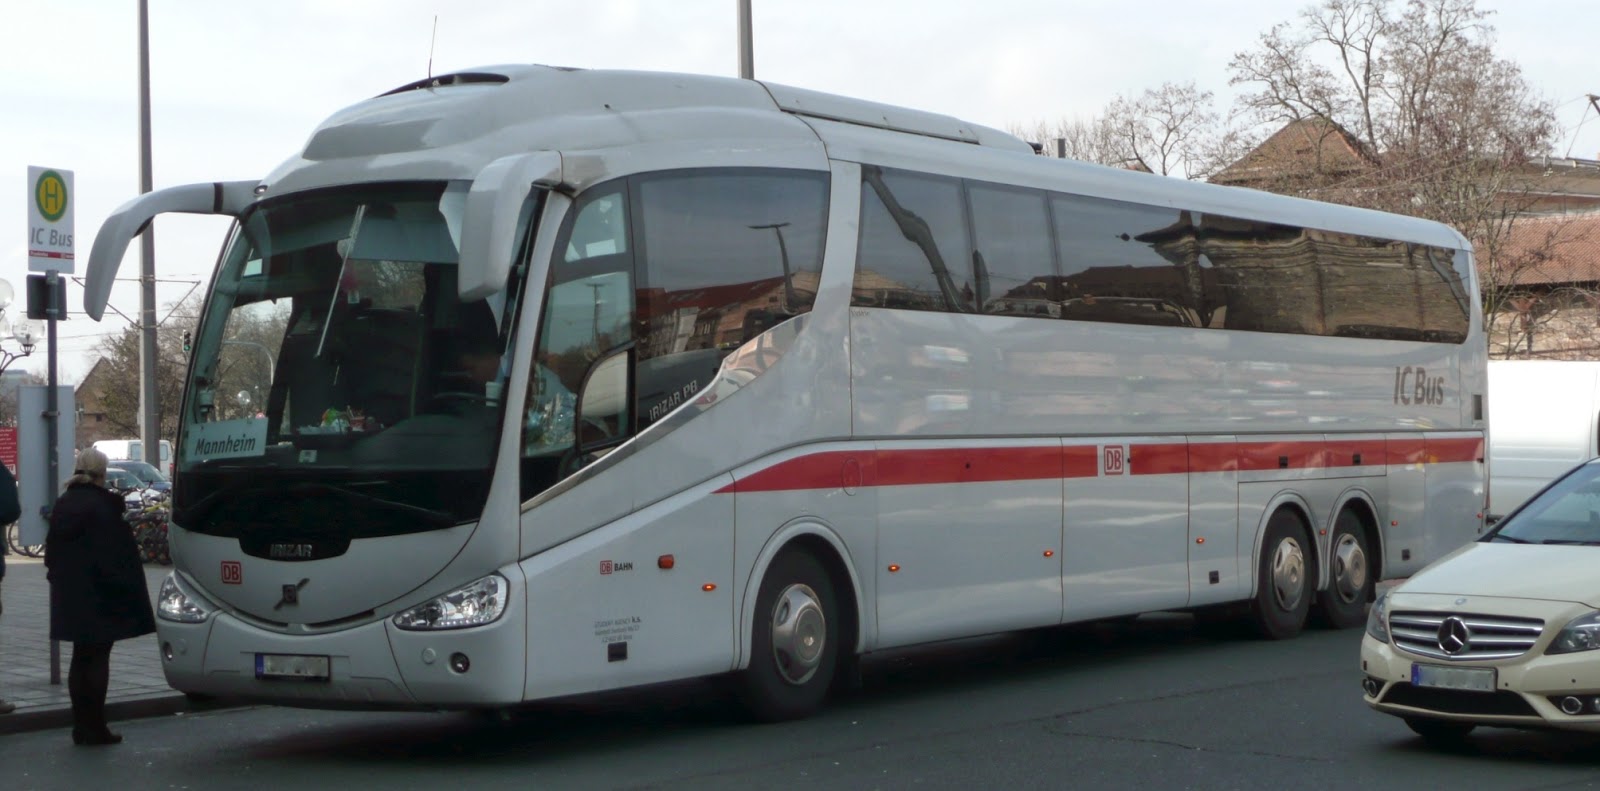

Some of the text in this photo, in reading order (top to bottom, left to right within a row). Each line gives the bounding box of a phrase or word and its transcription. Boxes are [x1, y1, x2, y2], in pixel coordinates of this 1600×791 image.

[45, 181, 58, 210] H
[31, 227, 73, 247] IC Bus
[1393, 366, 1445, 406] IC Bus
[649, 380, 698, 422] IRIZAR PB
[195, 434, 256, 456] Mannheim
[1106, 448, 1122, 472] DB
[270, 543, 313, 558] IRIZAR
[222, 563, 240, 582] DB
[601, 562, 633, 573] DB BAHN
